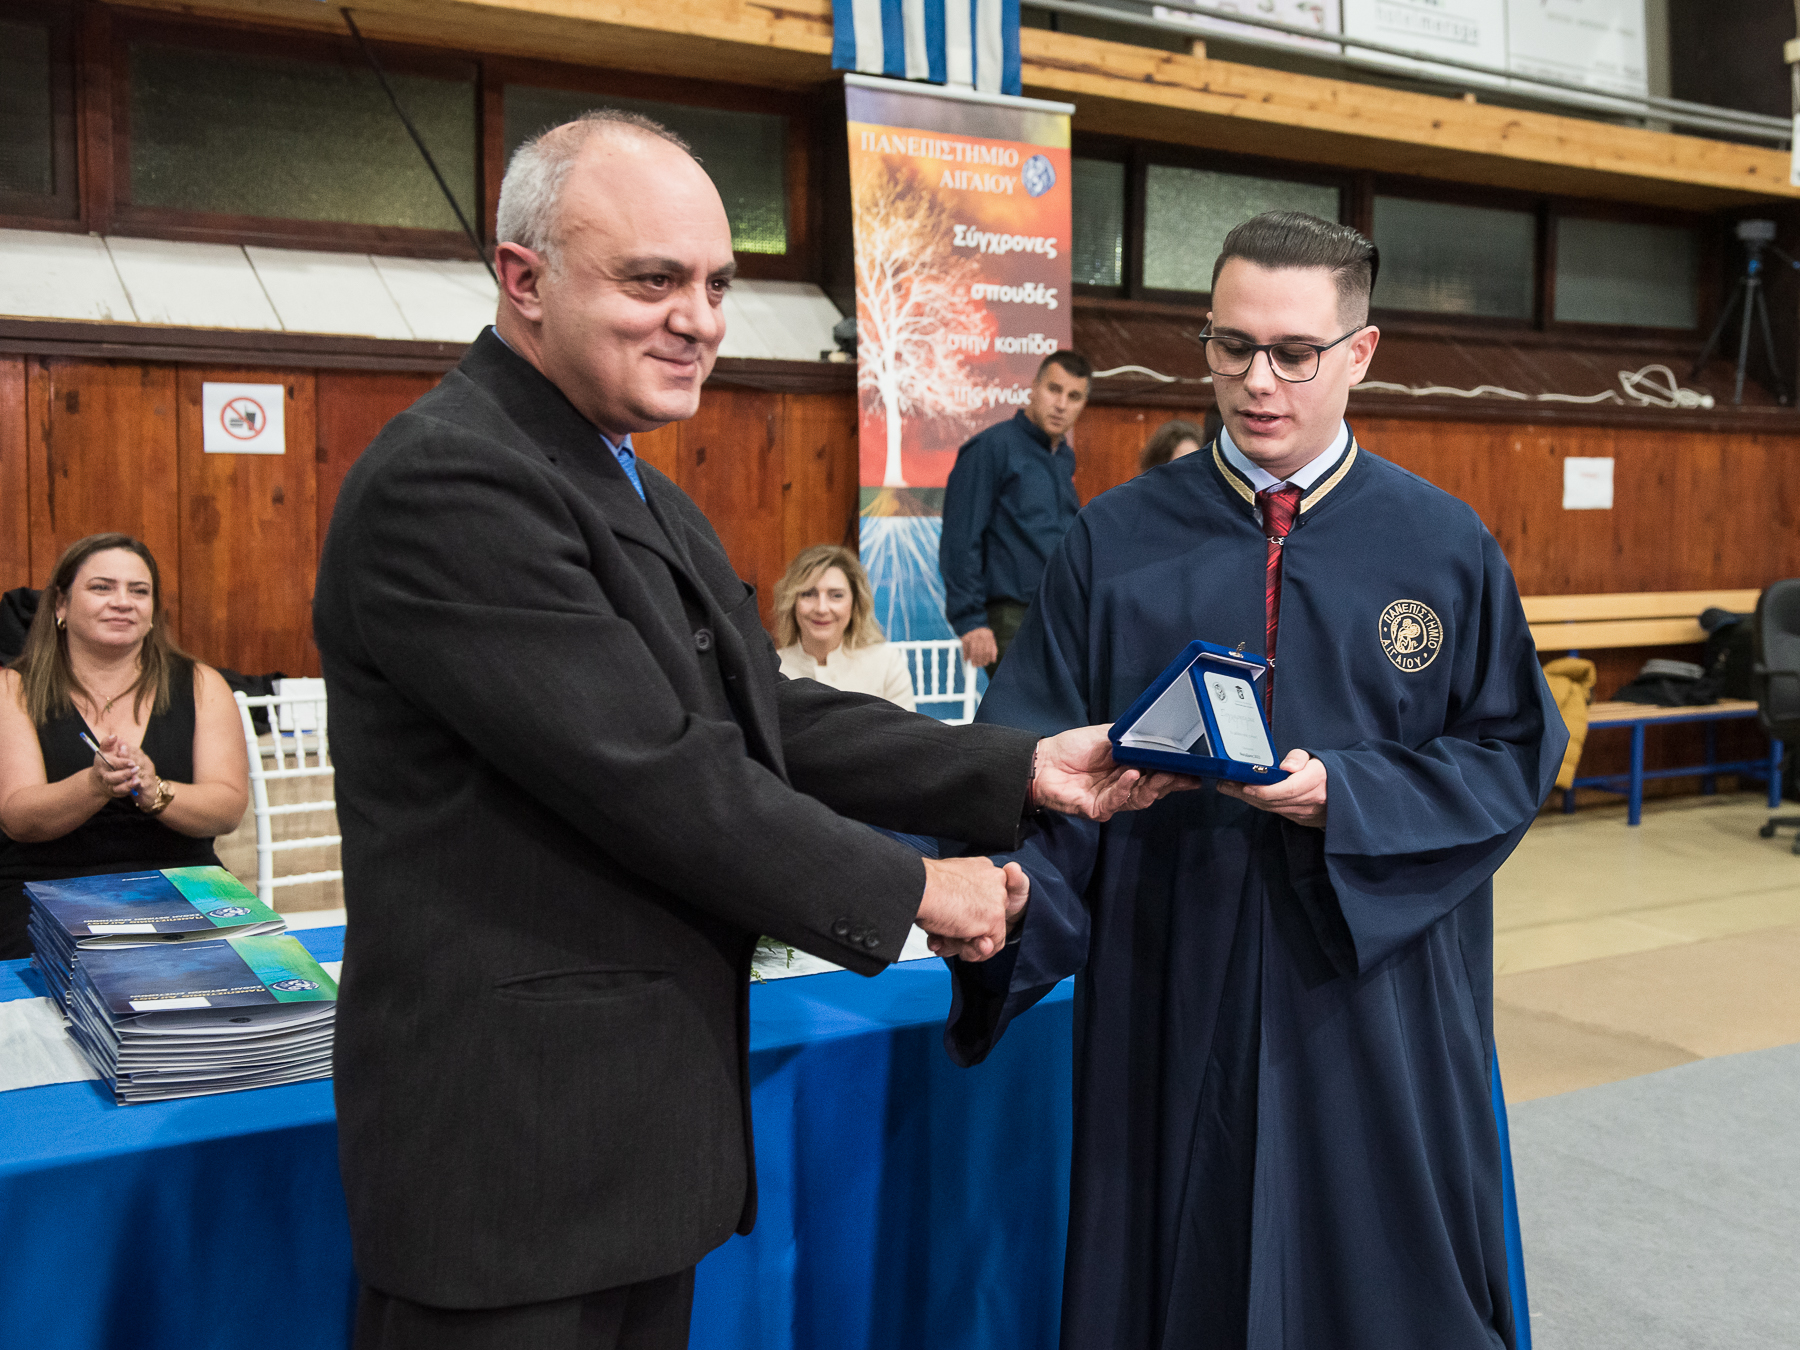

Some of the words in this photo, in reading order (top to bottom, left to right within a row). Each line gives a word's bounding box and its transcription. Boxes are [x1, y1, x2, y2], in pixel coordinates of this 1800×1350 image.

[861, 131, 1019, 168] ΠΑΝΕΠΙΣΤΗΜΙΟ
[939, 170, 1018, 195] ΑΙΓΑΙΟΥ
[953, 224, 1058, 259] Σύγχρονες
[970, 282, 1059, 310] σπουδές
[946, 333, 991, 356] στην
[1384, 604, 1440, 649] ΠΑΝΕΠΙΣΤΗΜΙΟ
[1381, 640, 1421, 669] ΑΙΓΑΙΟΥ
